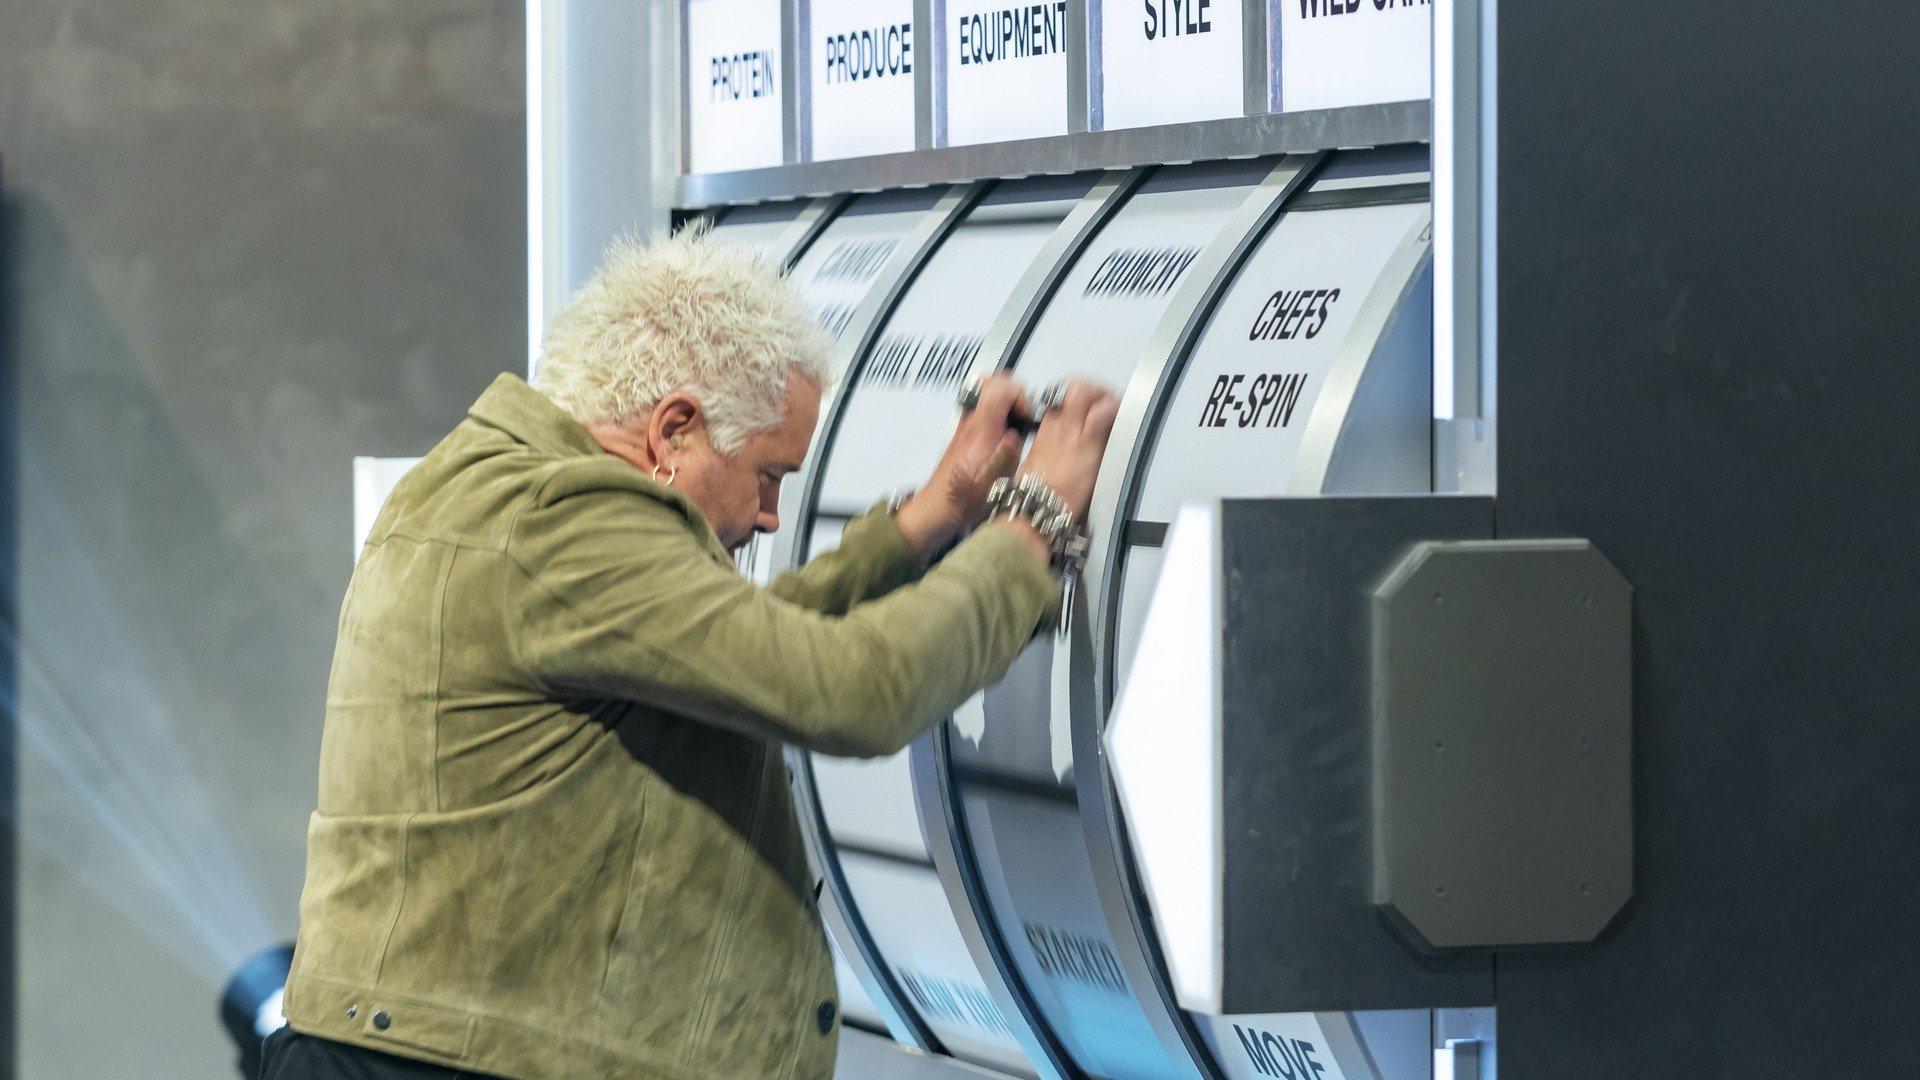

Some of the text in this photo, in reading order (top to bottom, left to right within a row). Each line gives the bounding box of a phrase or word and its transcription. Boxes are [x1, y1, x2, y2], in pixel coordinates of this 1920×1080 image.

[960, 2, 1066, 65] EQUIPMENT
[1144, 0, 1211, 40] STYLE
[711, 50, 774, 102] PROTEIN
[827, 23, 911, 84] PRODUCE
[1083, 247, 1200, 298] CRUNCHY
[1249, 288, 1341, 341] CHEFS
[1199, 373, 1308, 428] RE-SPIN
[1023, 920, 1129, 996] STACKED
[1233, 1024, 1325, 1080] MOVE
